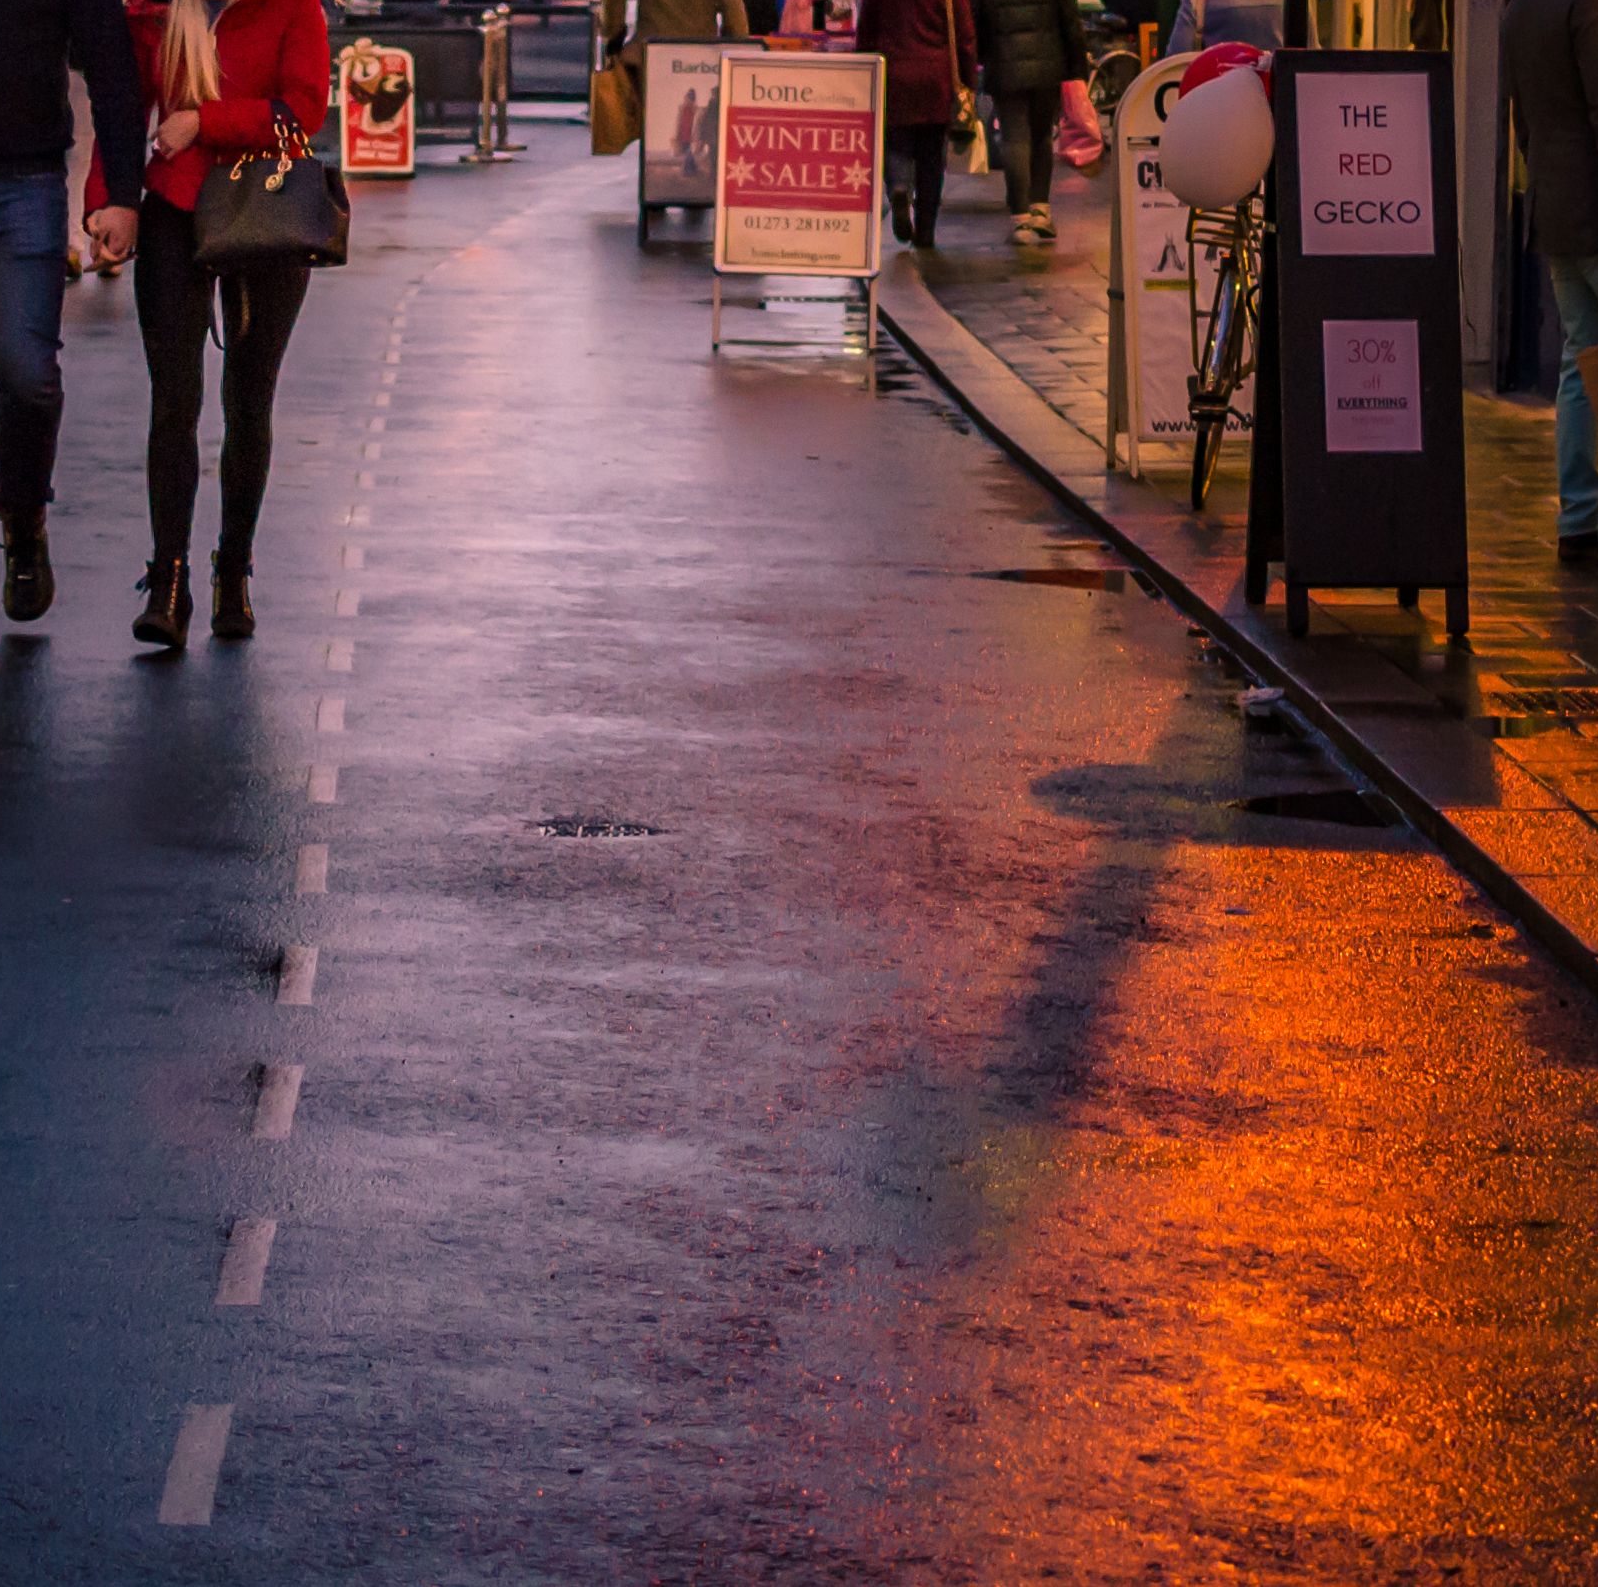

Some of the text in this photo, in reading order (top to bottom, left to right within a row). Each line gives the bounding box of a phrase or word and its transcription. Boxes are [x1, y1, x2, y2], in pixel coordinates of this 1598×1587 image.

[751, 73, 813, 103] bone
[1338, 104, 1387, 128] THE
[731, 124, 869, 153] WINTER
[759, 163, 838, 189] SALE
[1338, 153, 1392, 177] RED
[744, 215, 851, 233] 01273 281892
[1313, 200, 1421, 225] GECKO
[1347, 338, 1397, 363] 30%
[1337, 397, 1408, 409] EVERYTHING
